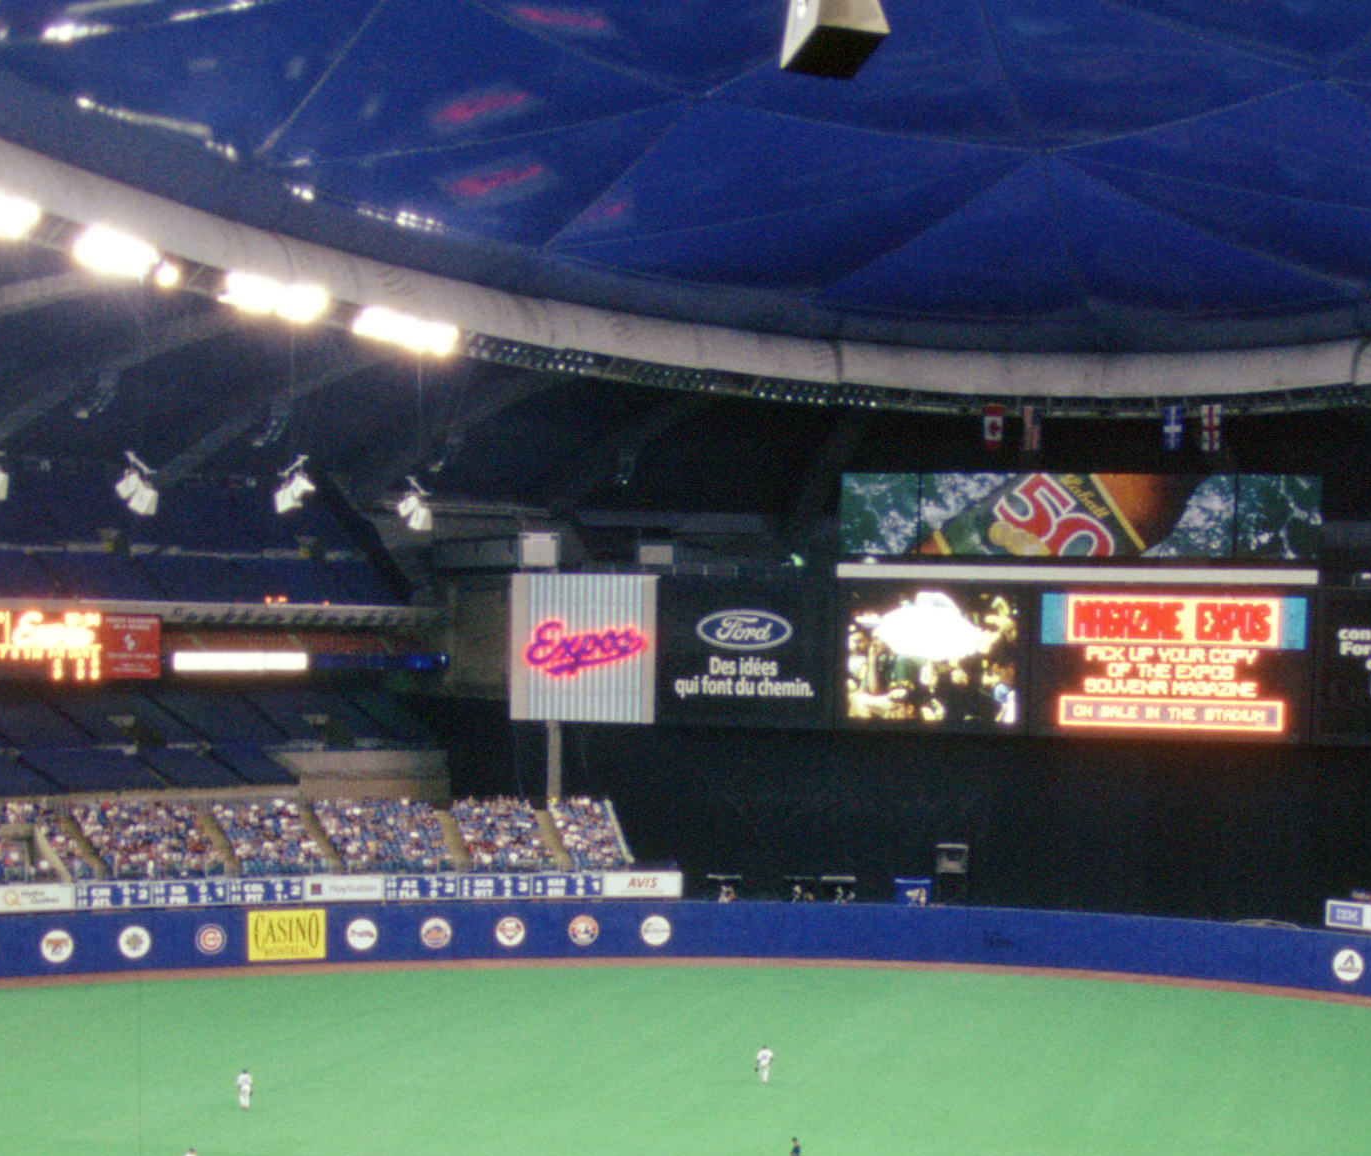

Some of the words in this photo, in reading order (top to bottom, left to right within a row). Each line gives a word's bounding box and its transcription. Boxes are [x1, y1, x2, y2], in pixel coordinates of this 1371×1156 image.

[716, 616, 772, 642] Ford
[1195, 602, 1271, 642] EXPOS
[525, 619, 647, 676] Expos
[1085, 645, 1125, 661] PICK
[1129, 646, 1154, 662] UP
[1157, 646, 1205, 663] YOUR
[1209, 648, 1258, 664] COPY
[709, 656, 736, 676] Des
[739, 655, 778, 676] idées
[1107, 662, 1132, 678] OF
[1137, 663, 1172, 679] THE
[1175, 664, 1235, 680] EXPOS
[675, 676, 699, 698] qui
[702, 676, 732, 696] font
[735, 677, 754, 696] du
[757, 677, 814, 697] chemin.
[1084, 678, 1169, 695] SOUVENIR
[1171, 680, 1258, 698] MAGAZINE
[1073, 704, 1093, 718] ON
[1145, 706, 1160, 719] IN
[1167, 707, 1196, 720] THE
[627, 876, 658, 889] AVIS
[1335, 907, 1359, 922] IBM
[253, 912, 319, 951] CASINO
